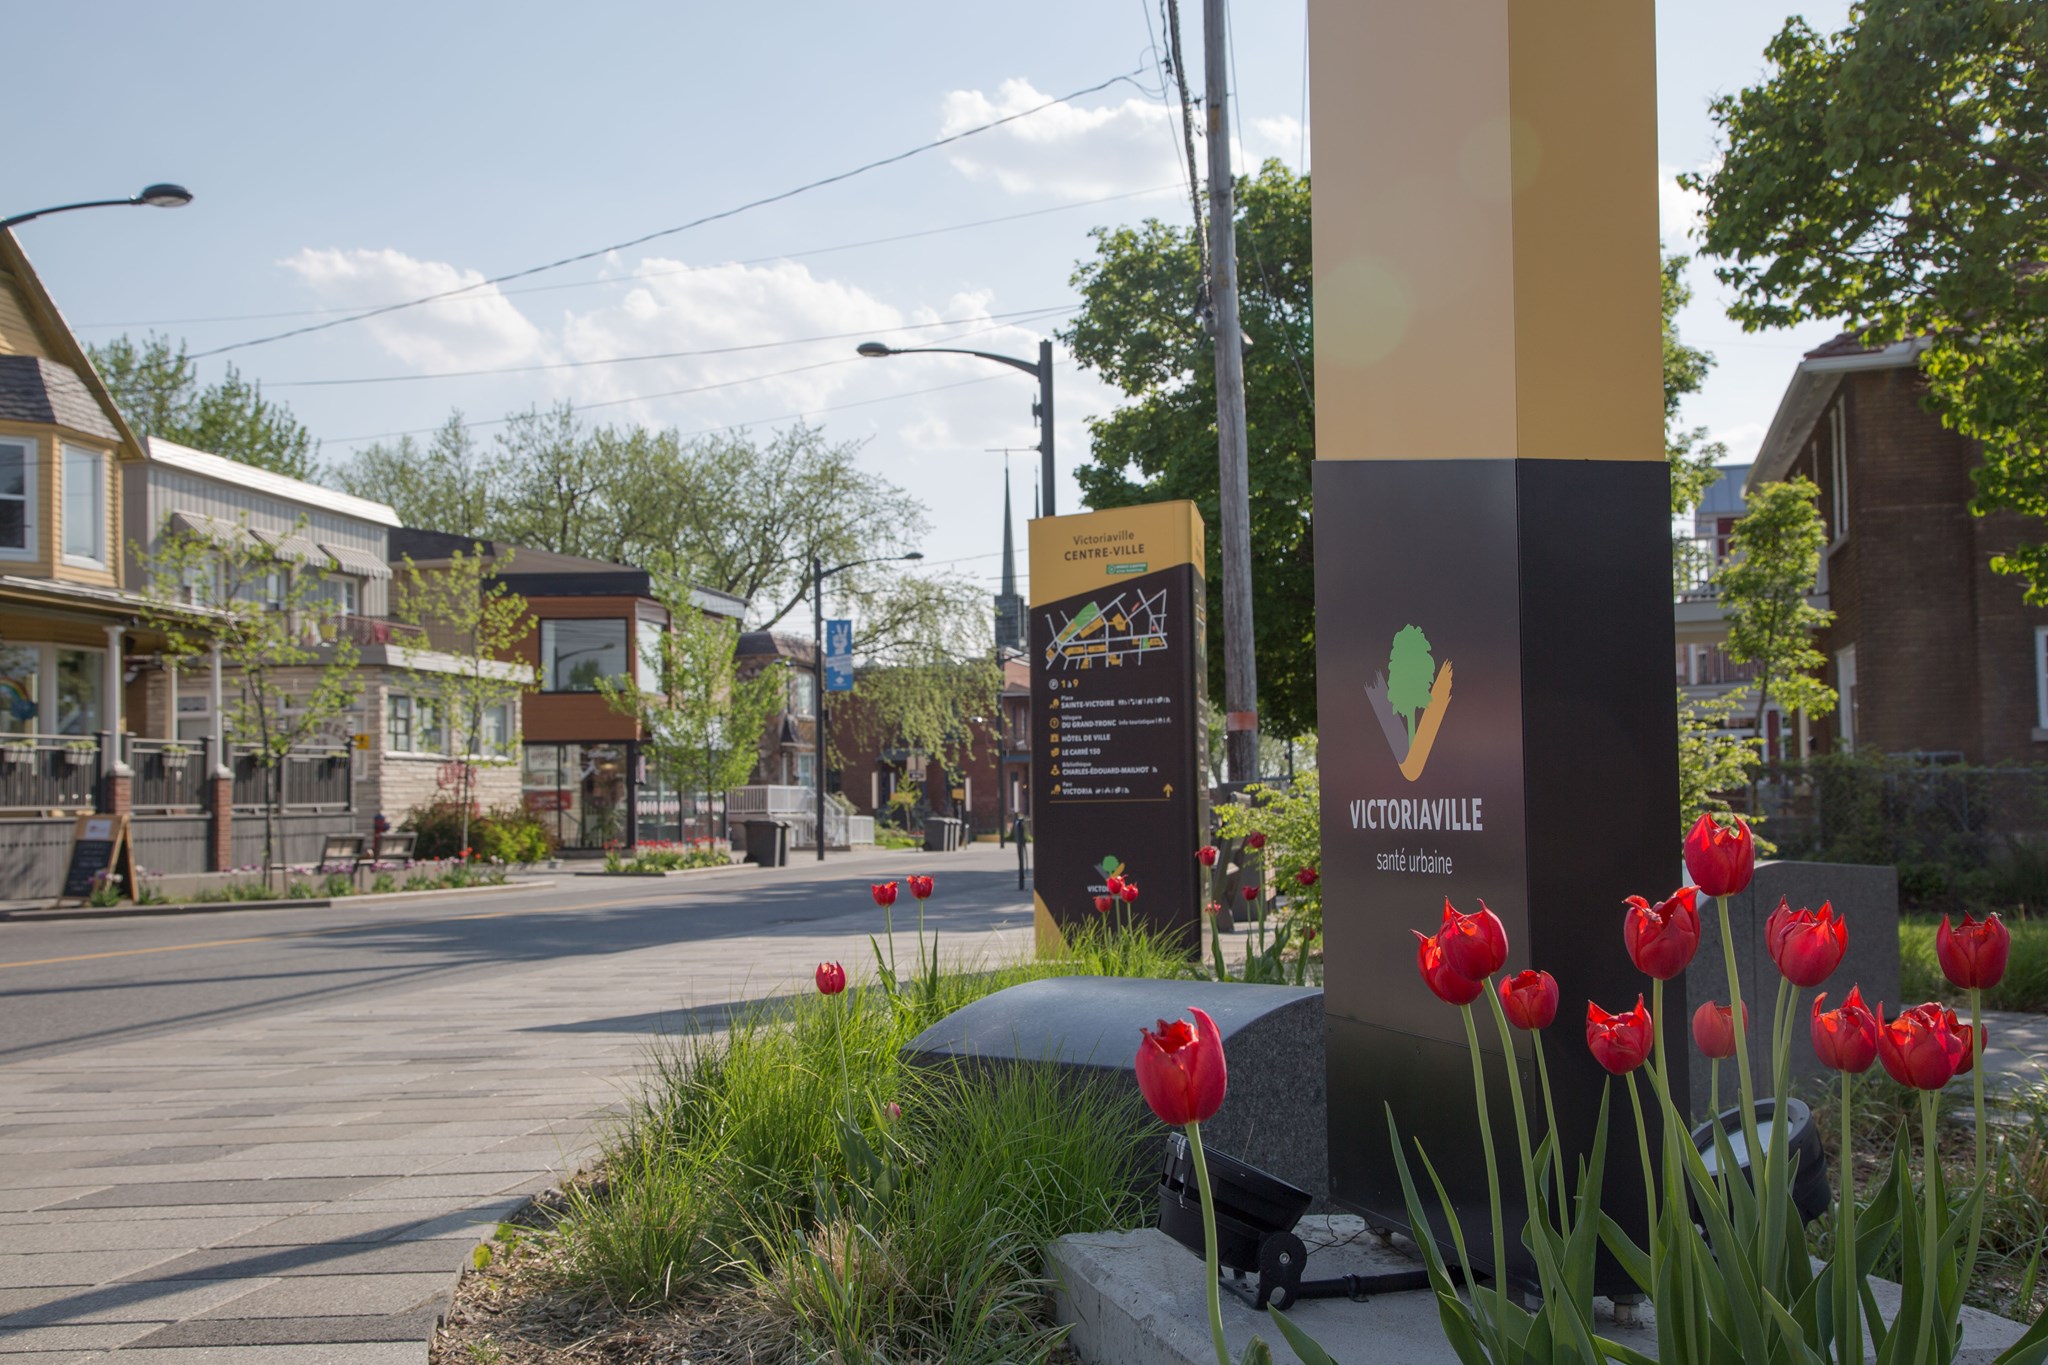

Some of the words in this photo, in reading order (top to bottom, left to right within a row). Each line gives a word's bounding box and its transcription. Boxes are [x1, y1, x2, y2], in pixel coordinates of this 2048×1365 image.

[1073, 530, 1134, 546] Victoriaville
[1064, 543, 1145, 561] CENTRE-VILLE
[1061, 680, 1066, 688] 1
[1073, 679, 1079, 688] 9
[1061, 700, 1115, 709] SAINTE-VICTOIRE
[1061, 720, 1071, 729] DU
[1072, 720, 1117, 728] GRAND-TRONC
[1061, 733, 1082, 742] HÔTEL
[1083, 734, 1092, 742] DE
[1093, 733, 1111, 742] VILLE
[1069, 747, 1089, 756] CARRÉ
[1089, 748, 1101, 756] 150
[1062, 767, 1149, 775] CHARLES-ÉDOUARD-MAILHOT
[1062, 787, 1093, 796] VICTORIA
[1349, 798, 1483, 831] VICTORIAVILLE
[1376, 847, 1406, 872] santé
[1409, 848, 1453, 875] urbaine
